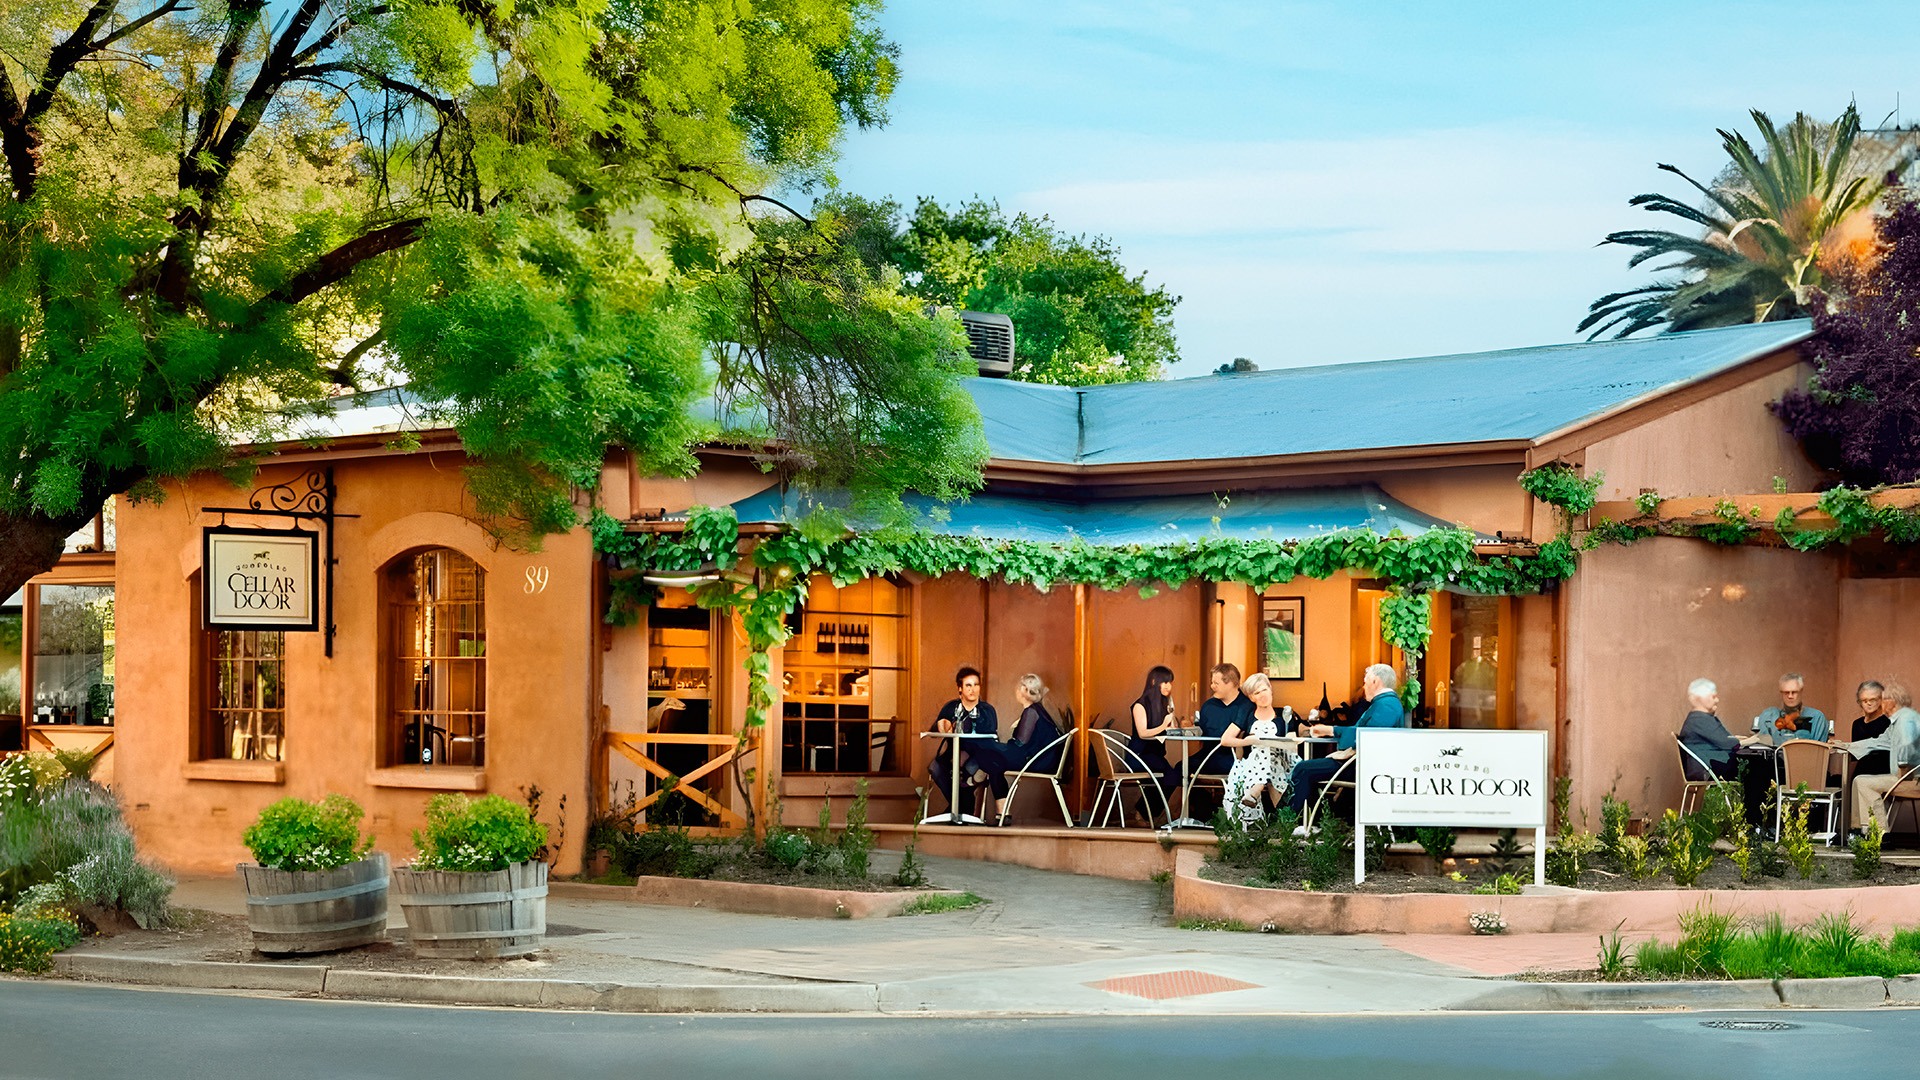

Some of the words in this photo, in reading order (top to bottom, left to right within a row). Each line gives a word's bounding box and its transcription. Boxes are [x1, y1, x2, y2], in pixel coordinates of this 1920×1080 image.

[227, 572, 296, 593] CELLAR
[523, 565, 549, 594] 89
[234, 592, 291, 610] DOOR
[1370, 774, 1454, 796] CELLAR
[1461, 778, 1532, 797] DOOR
